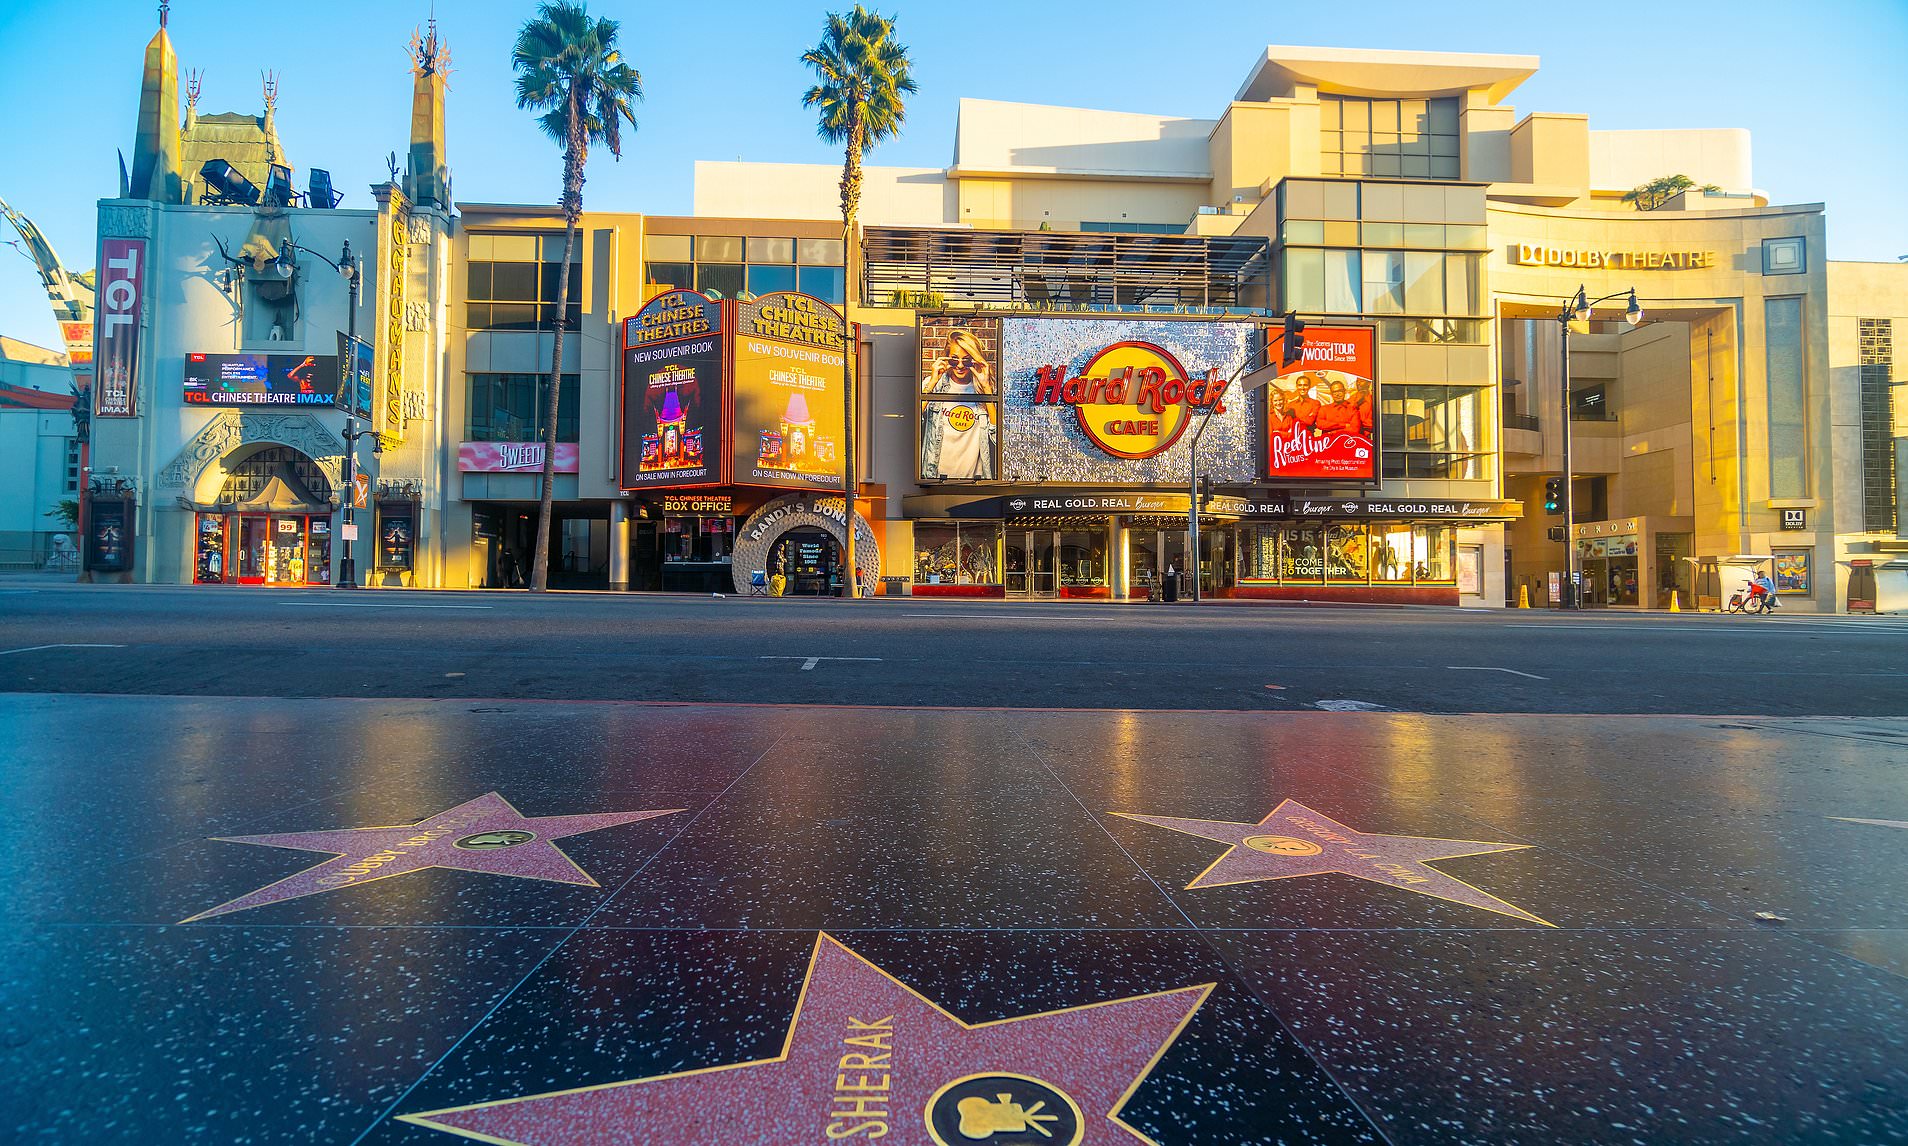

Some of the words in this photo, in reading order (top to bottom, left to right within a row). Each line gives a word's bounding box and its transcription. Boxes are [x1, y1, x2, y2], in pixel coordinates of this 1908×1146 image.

[1549, 247, 1611, 268] DOLBY
[1620, 251, 1715, 268] THEATRE
[105, 249, 137, 338] TCL
[659, 294, 686, 308] TCL
[783, 294, 818, 313] TCL
[641, 304, 704, 327] CHINESE
[761, 306, 838, 332] CHINESE
[636, 319, 710, 342] THEATRES
[753, 319, 845, 348] THEATRES
[634, 351, 652, 363] NEW
[652, 346, 690, 360] SOUVENIR
[691, 341, 713, 354] BOOK
[748, 342, 771, 354] NEW
[773, 346, 820, 362] SOUVENIR
[1334, 343, 1355, 354] TOUR
[649, 372, 671, 384] CHINESE
[672, 368, 695, 381] THEATRE
[790, 366, 807, 374] TCL
[769, 370, 797, 384] CHINESE
[798, 373, 826, 388] THEATRE
[1035, 364, 1134, 405] Hard
[1139, 366, 1228, 414] Rock
[185, 392, 210, 402] TCL
[211, 392, 253, 403] CHINESE
[254, 393, 295, 403] THEATRE
[297, 394, 334, 404] IMAX
[962, 409, 979, 421] Roc
[1111, 420, 1159, 435] CAFE
[635, 473, 644, 481] ON
[644, 472, 657, 480] SALE
[657, 471, 670, 480] NOW
[676, 468, 707, 478] FORECOURT
[752, 469, 762, 477] ON
[763, 470, 780, 479] SALE
[780, 472, 796, 480] NOW
[804, 474, 840, 483] FORECOURT
[664, 502, 688, 511] BOX
[692, 502, 731, 511] OFFICE
[1034, 500, 1062, 508] REAL
[1065, 499, 1098, 508] GOLD.
[1102, 498, 1130, 507] REAL
[1210, 501, 1231, 510] REAL
[1234, 503, 1257, 513] GOLD.
[1368, 504, 1395, 513] REAL
[1397, 505, 1429, 513] GOLD.
[1431, 505, 1458, 513] REAL
[1579, 522, 1635, 535] GROM
[1295, 558, 1323, 566] COME
[1295, 567, 1346, 575] TOGETHER
[316, 849, 408, 885] CUBBY
[1343, 848, 1381, 860] LA
[1373, 863, 1429, 884] CAVA
[826, 1014, 895, 1139] SHERAK
